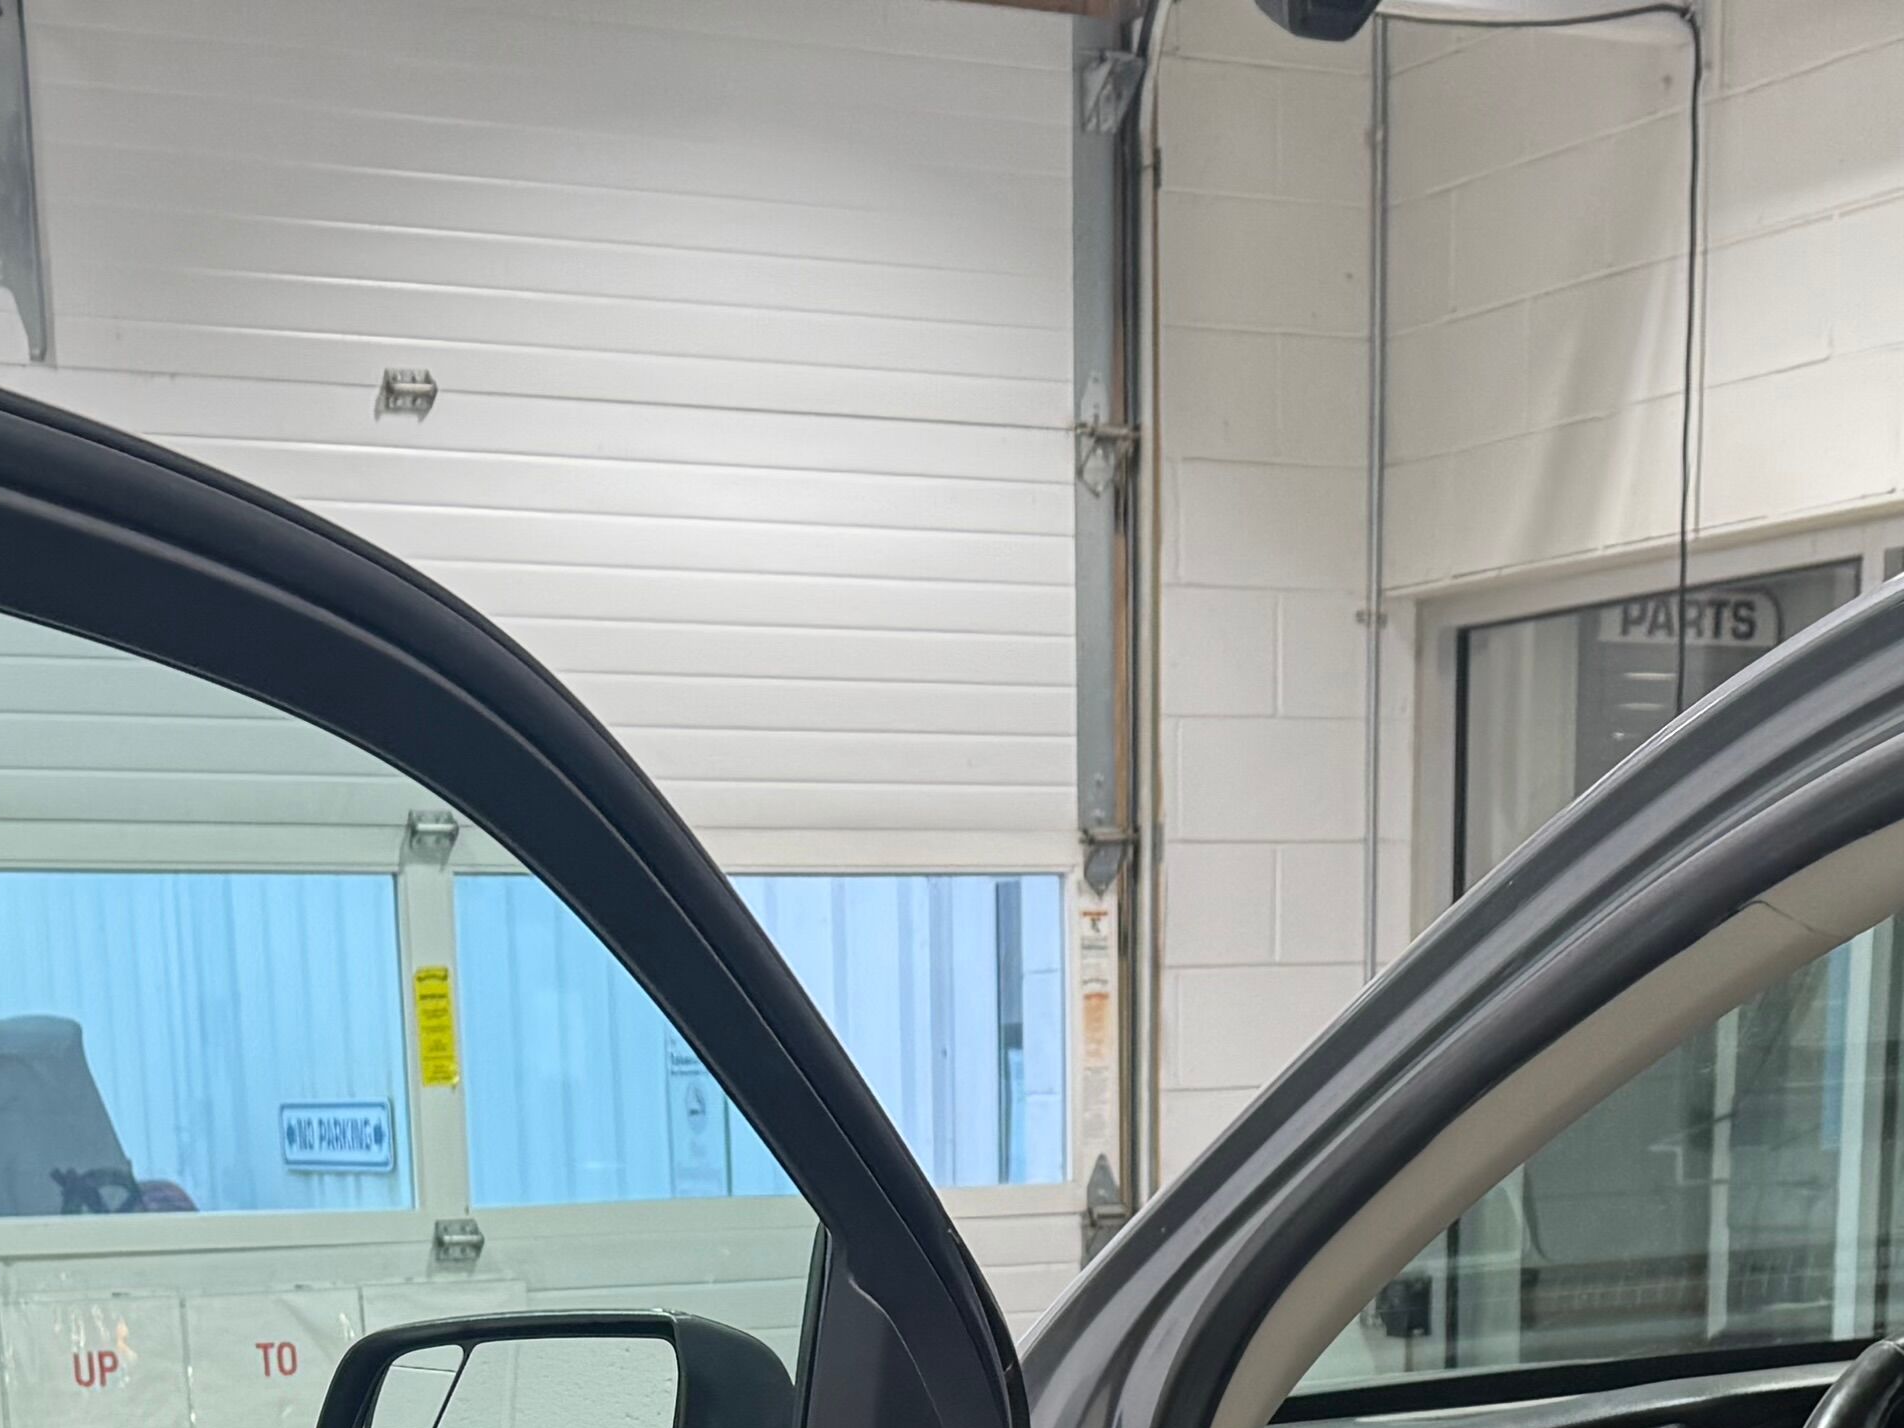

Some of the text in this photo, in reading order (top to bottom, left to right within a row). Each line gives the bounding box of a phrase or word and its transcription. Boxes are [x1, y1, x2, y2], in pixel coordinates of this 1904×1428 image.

[1619, 598, 1758, 641] PARTS
[296, 1116, 373, 1151] NO PARKING
[72, 1350, 120, 1388] UP
[255, 1341, 298, 1378] TO
